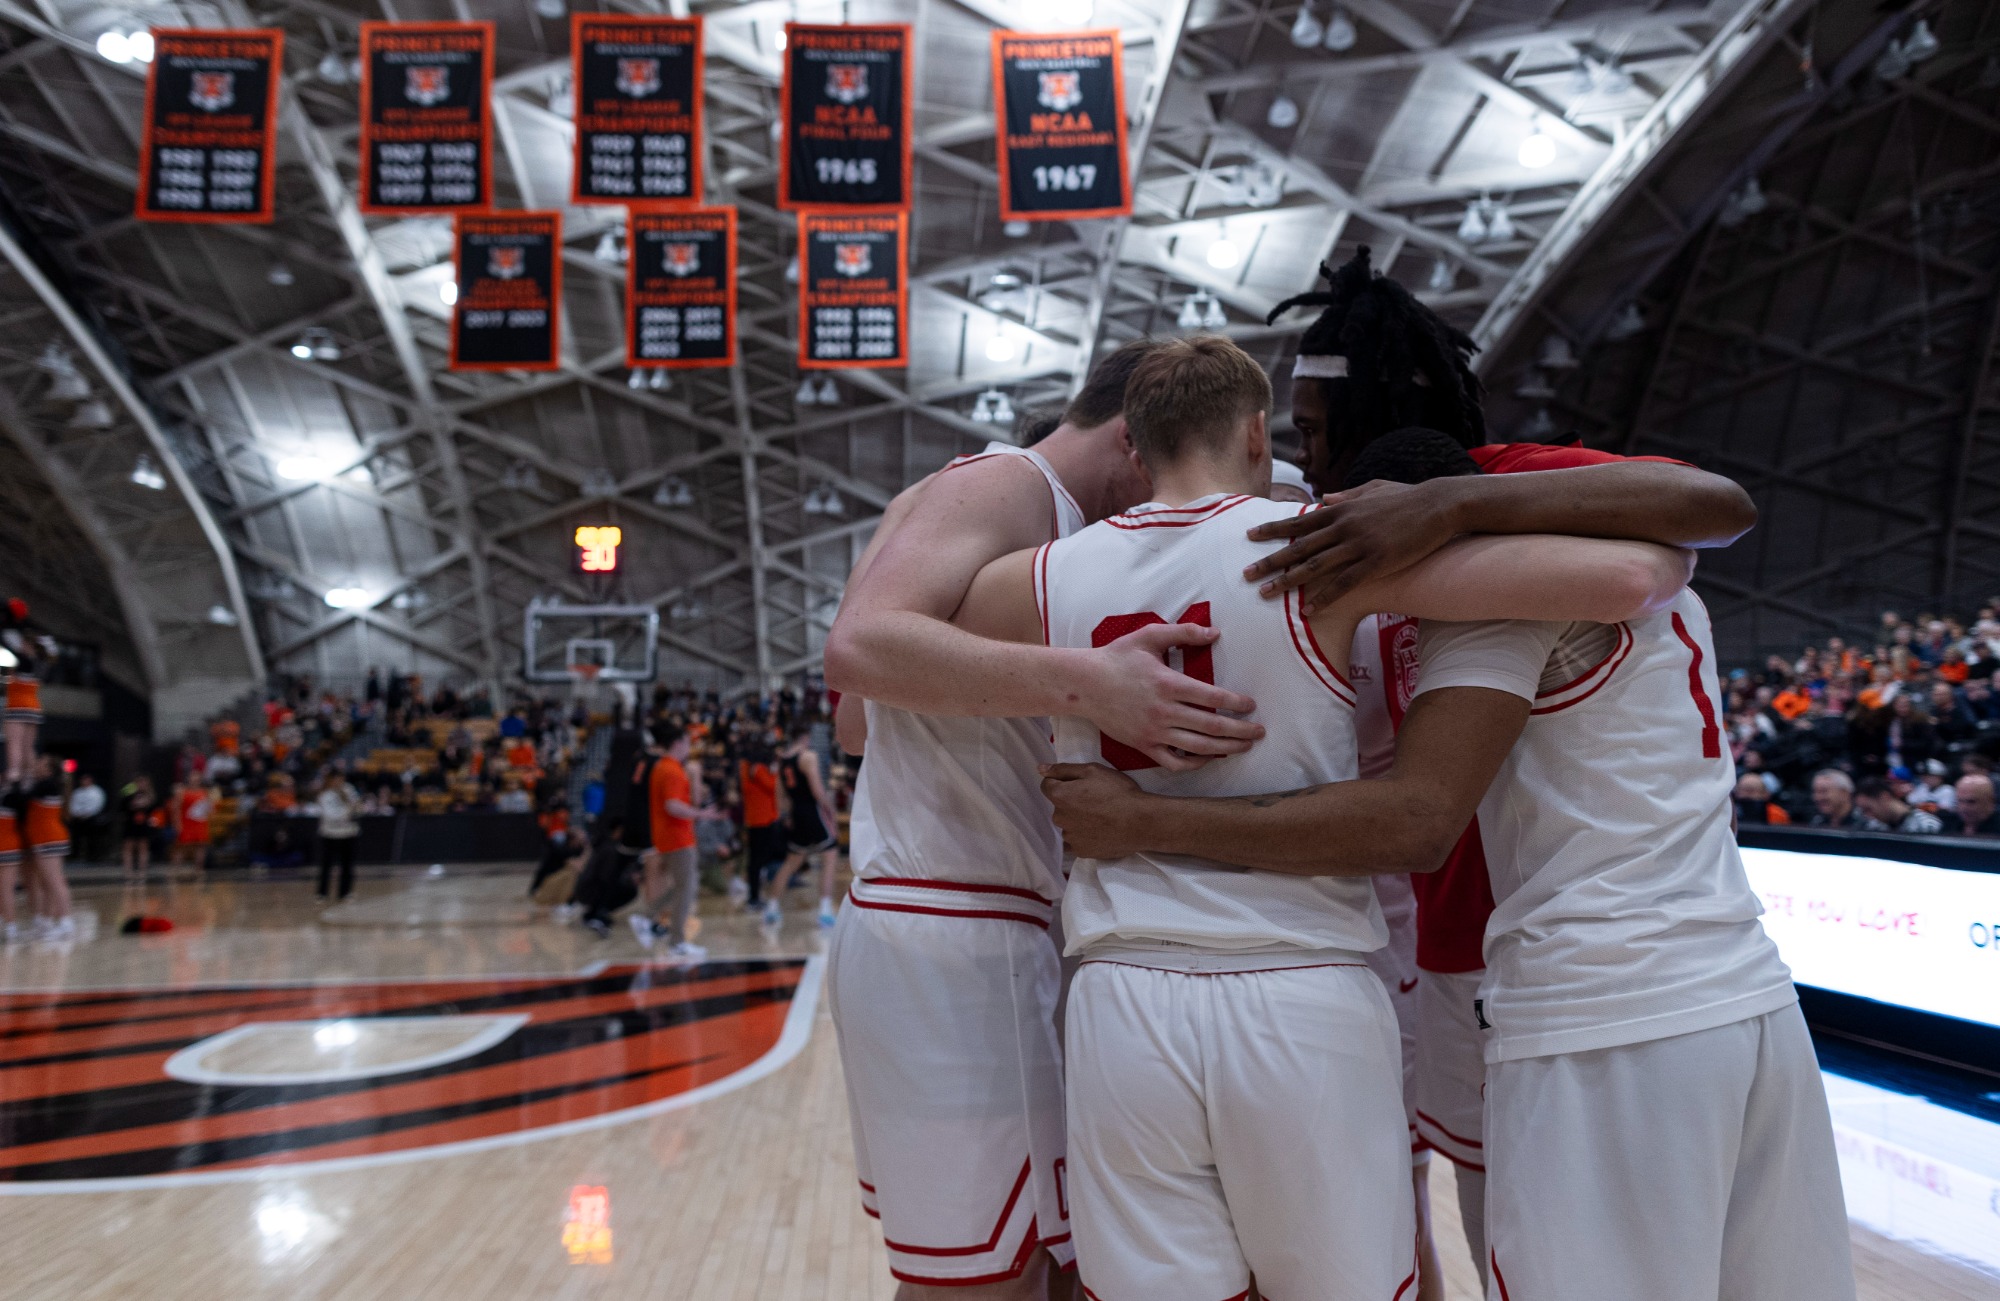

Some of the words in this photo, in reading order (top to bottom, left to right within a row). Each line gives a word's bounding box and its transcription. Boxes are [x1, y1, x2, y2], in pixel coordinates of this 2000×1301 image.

[1005, 41, 1111, 59] PRINCETON
[815, 106, 878, 125] NCAA
[1031, 113, 1093, 132] NCAA
[816, 159, 877, 183] 1965
[1034, 165, 1096, 191] 1967
[1670, 610, 1722, 759] 1
[1857, 906, 1922, 938] LOVE
